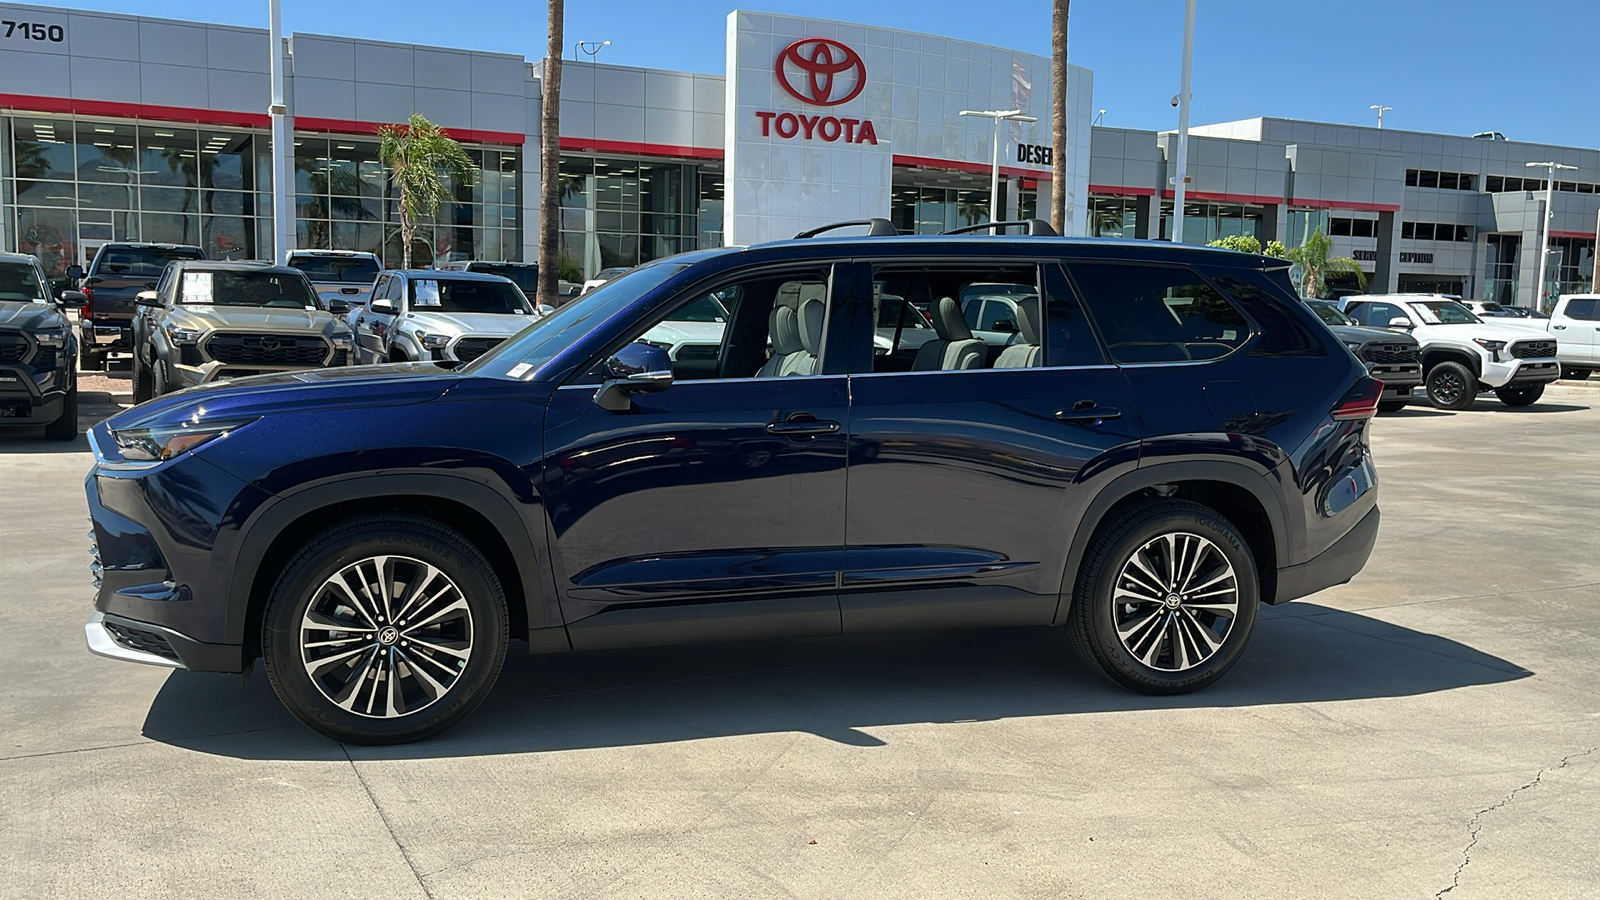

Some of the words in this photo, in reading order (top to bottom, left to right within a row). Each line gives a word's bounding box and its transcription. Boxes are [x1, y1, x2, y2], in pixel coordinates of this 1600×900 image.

[2, 20, 64, 43] 7150
[755, 111, 878, 145] TOYOTA
[1017, 143, 1053, 167] DESER
[1353, 250, 1377, 261] SERV
[1399, 252, 1434, 263] CEPTION
[1195, 515, 1241, 552] YOKOHAMA
[378, 534, 450, 560] YOKOHAMA
